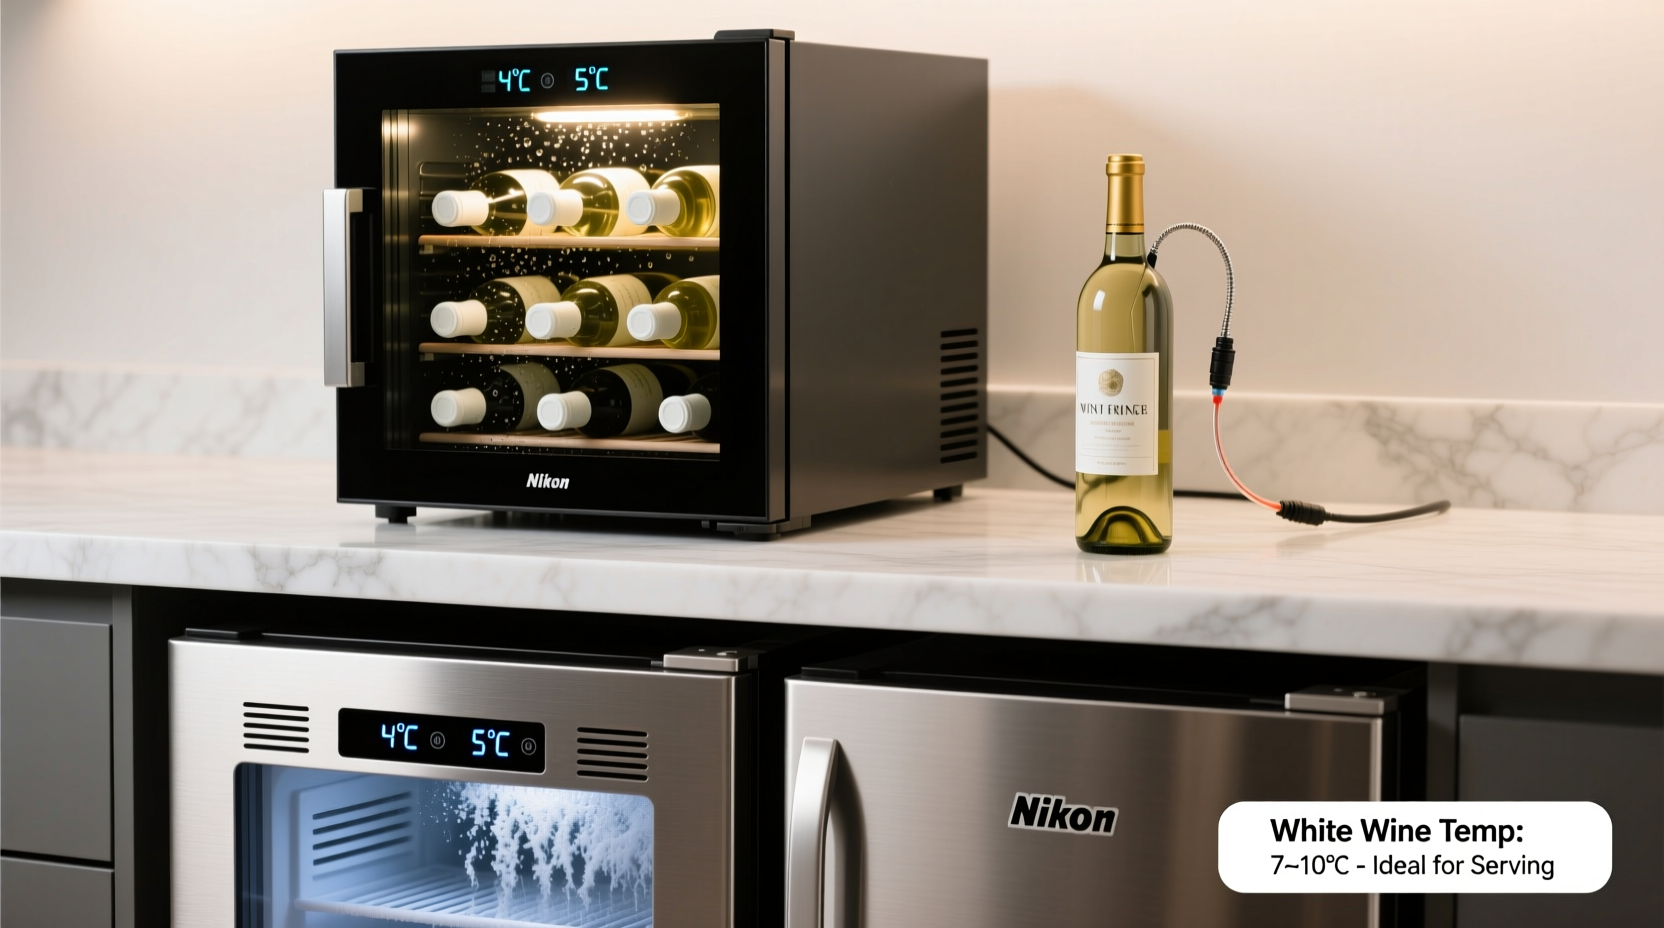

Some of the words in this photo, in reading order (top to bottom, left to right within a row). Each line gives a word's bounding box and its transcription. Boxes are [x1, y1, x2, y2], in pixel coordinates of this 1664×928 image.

[499, 68, 531, 92] 4°C
[574, 66, 609, 92] 5°C
[526, 472, 570, 490] Nikon
[381, 722, 419, 750] 4°C
[471, 729, 511, 757] 5°C
[1008, 793, 1118, 836] Nikon
